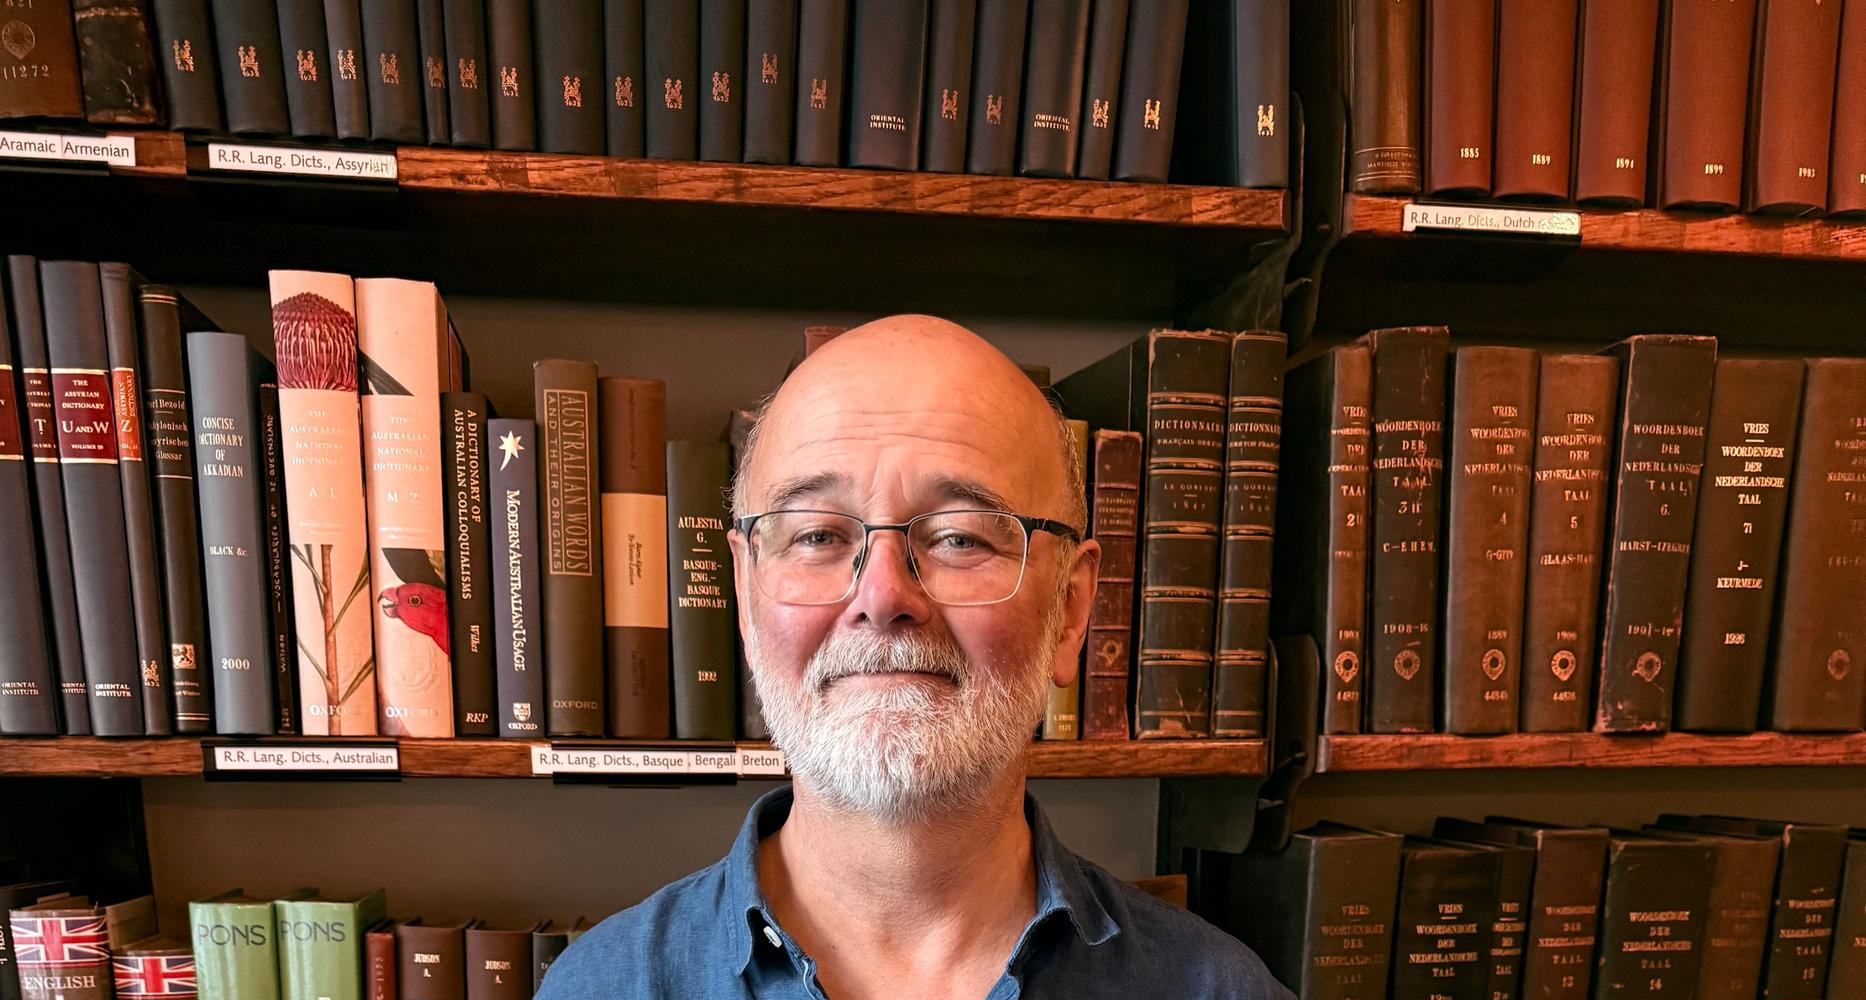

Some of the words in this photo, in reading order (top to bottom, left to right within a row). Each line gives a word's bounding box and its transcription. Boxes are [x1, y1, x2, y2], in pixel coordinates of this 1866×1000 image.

[3, 64, 50, 80] 11272
[0, 137, 56, 154] Aramaic
[63, 140, 130, 158] Armenian
[218, 149, 246, 163] R.R.
[249, 151, 287, 168] Lang.
[290, 153, 332, 171] Dicts.,
[335, 156, 389, 174] Assyrian
[1705, 163, 1724, 175] 1899
[1411, 212, 1431, 225] R.R.
[1435, 213, 1463, 227] Lang.
[1503, 216, 1535, 229] Dutch
[159, 400, 185, 410] Bezold
[467, 410, 477, 418] A
[547, 396, 558, 430] AND
[1492, 406, 1518, 417] VRIES
[202, 417, 235, 430] CONCISE
[1567, 413, 1594, 425] VRIES
[62, 421, 74, 433] U
[94, 421, 110, 434] W
[121, 420, 132, 433] Z
[1633, 424, 1704, 436] WOORDENBOEK
[1743, 423, 1769, 434] VRIES
[199, 433, 243, 447] DICTIONARY
[454, 409, 468, 488] AUSTRALIAN
[561, 395, 586, 507] AUSTRALIAN
[1661, 443, 1680, 454] DER
[1721, 446, 1784, 458] WOORDENBOEK
[215, 449, 225, 461] OF
[1569, 450, 1590, 461] DER
[468, 422, 480, 502] DICTIONARY
[549, 439, 559, 489] THEIR
[1744, 462, 1762, 472] DER
[203, 465, 243, 477] AKKADIAN
[1715, 476, 1785, 488] NEDERLANDSCHE
[1738, 494, 1761, 505] TAAL
[471, 505, 481, 523] OF
[506, 490, 521, 548] MODERN
[678, 516, 724, 530] AULESTIA
[1570, 517, 1578, 529] 5
[551, 498, 562, 570] ORIGINS
[696, 532, 708, 544] G.
[457, 491, 472, 600] COLLOQUIALISMS
[566, 512, 588, 570] WORDS
[210, 546, 233, 556] BLACK
[683, 560, 722, 571] BASQUE-
[690, 572, 717, 583] ENG.-
[1716, 578, 1762, 589] KEURMEDE
[508, 548, 524, 629] AUSTRALIAN
[687, 584, 721, 596] BASQUE
[678, 597, 728, 609] DICTIONARY
[512, 629, 527, 672] USAGE
[221, 658, 250, 670] 2000
[1, 688, 39, 696] INSTITUTE
[94, 683, 130, 691] ORIENTAL
[553, 701, 598, 710] OXFORD
[466, 713, 488, 723] RKP
[508, 722, 538, 731] OXFORD
[223, 751, 250, 762] R.R.
[253, 751, 286, 765] Lang.
[291, 751, 329, 765] Dicts.,
[333, 751, 393, 764] Australian
[540, 753, 566, 765] R.R.
[567, 754, 600, 768] Lang.
[603, 754, 640, 767] Dicts.,
[695, 754, 736, 769] Bengali
[742, 754, 779, 767] Breton
[1438, 904, 1463, 914] VRIES
[198, 924, 266, 946] PONS
[280, 921, 346, 942] PONS
[1416, 923, 1478, 935] WOORDENBOEK
[1437, 939, 1455, 948] DER
[414, 953, 440, 964] JUDSON
[1409, 952, 1478, 963] NEDERLANDSCHE
[485, 961, 511, 970] JUDSON
[424, 969, 431, 977] A.
[1432, 968, 1455, 977] TAAL
[24, 976, 96, 989] ENGLISH
[495, 975, 502, 984] A.
